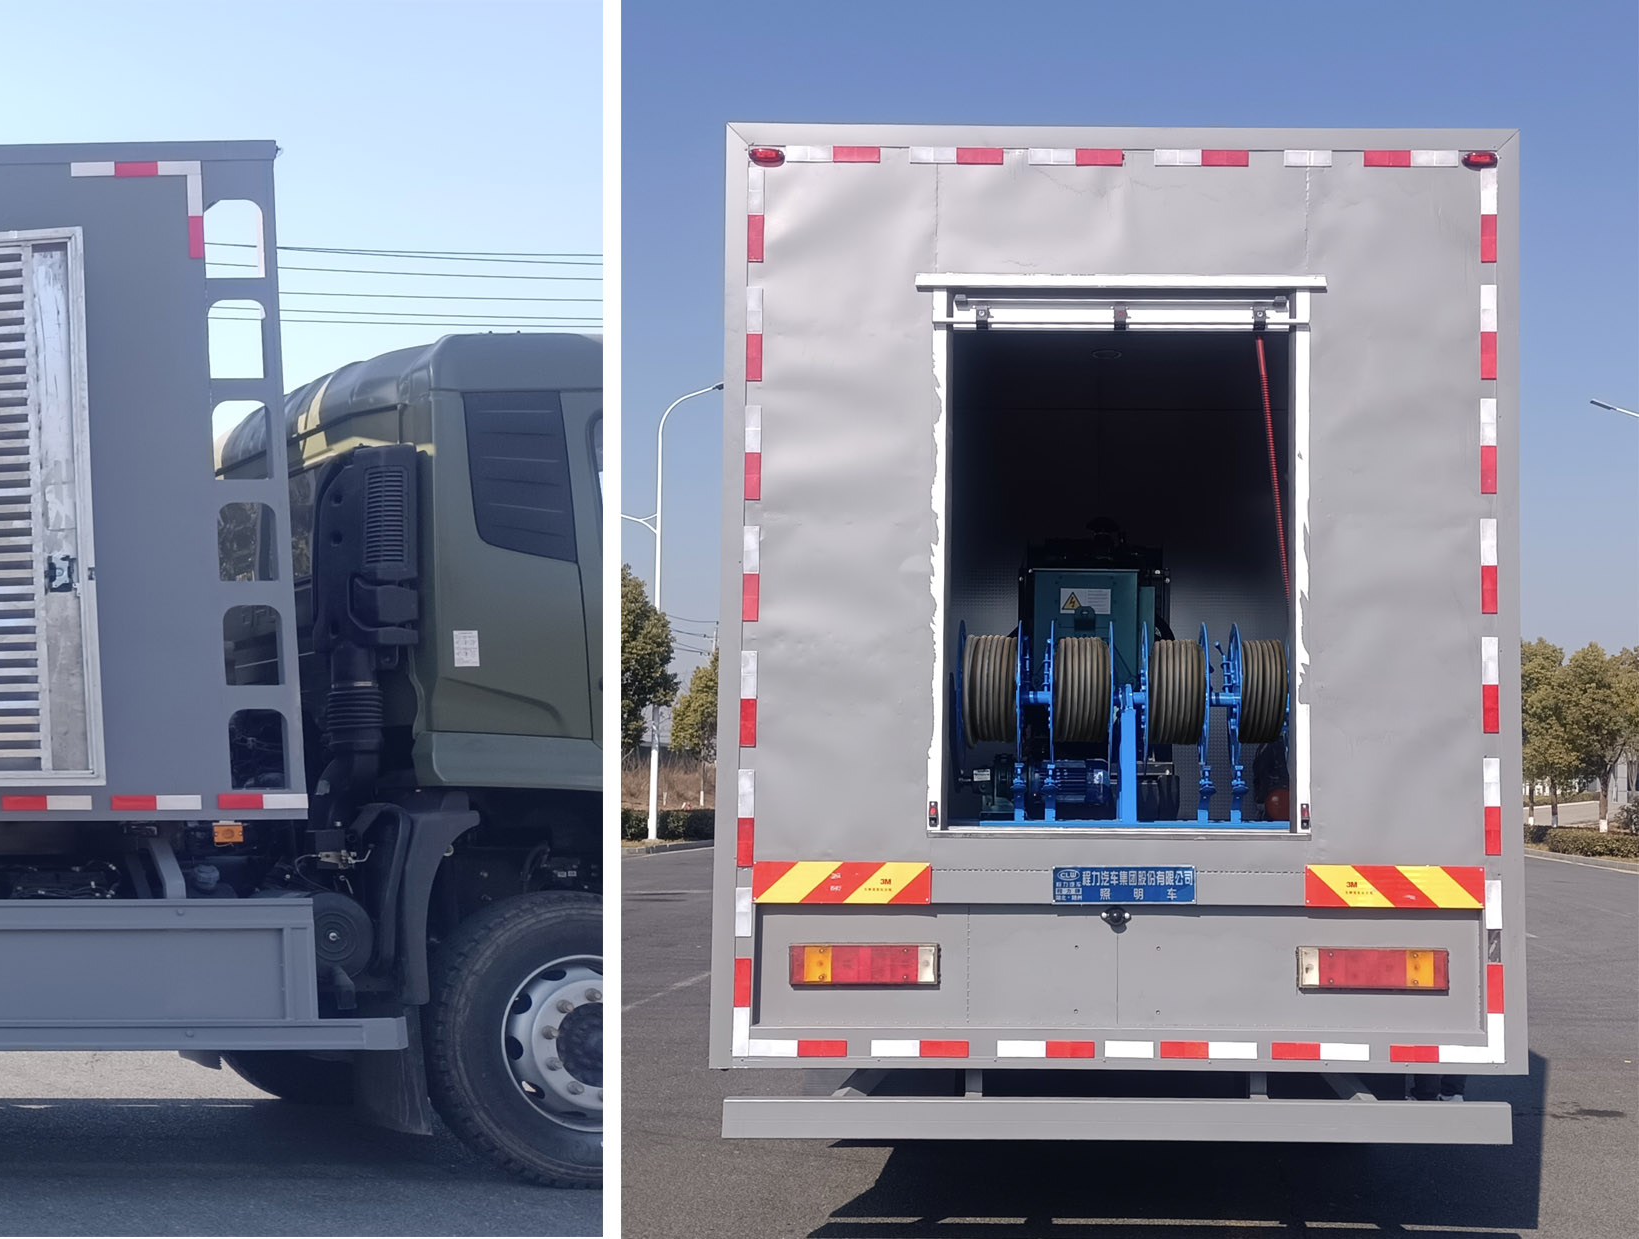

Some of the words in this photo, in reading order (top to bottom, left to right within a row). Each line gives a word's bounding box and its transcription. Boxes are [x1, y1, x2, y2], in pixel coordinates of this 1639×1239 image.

[1082, 870, 1193, 886] 程力汽车集团股份有限公司
